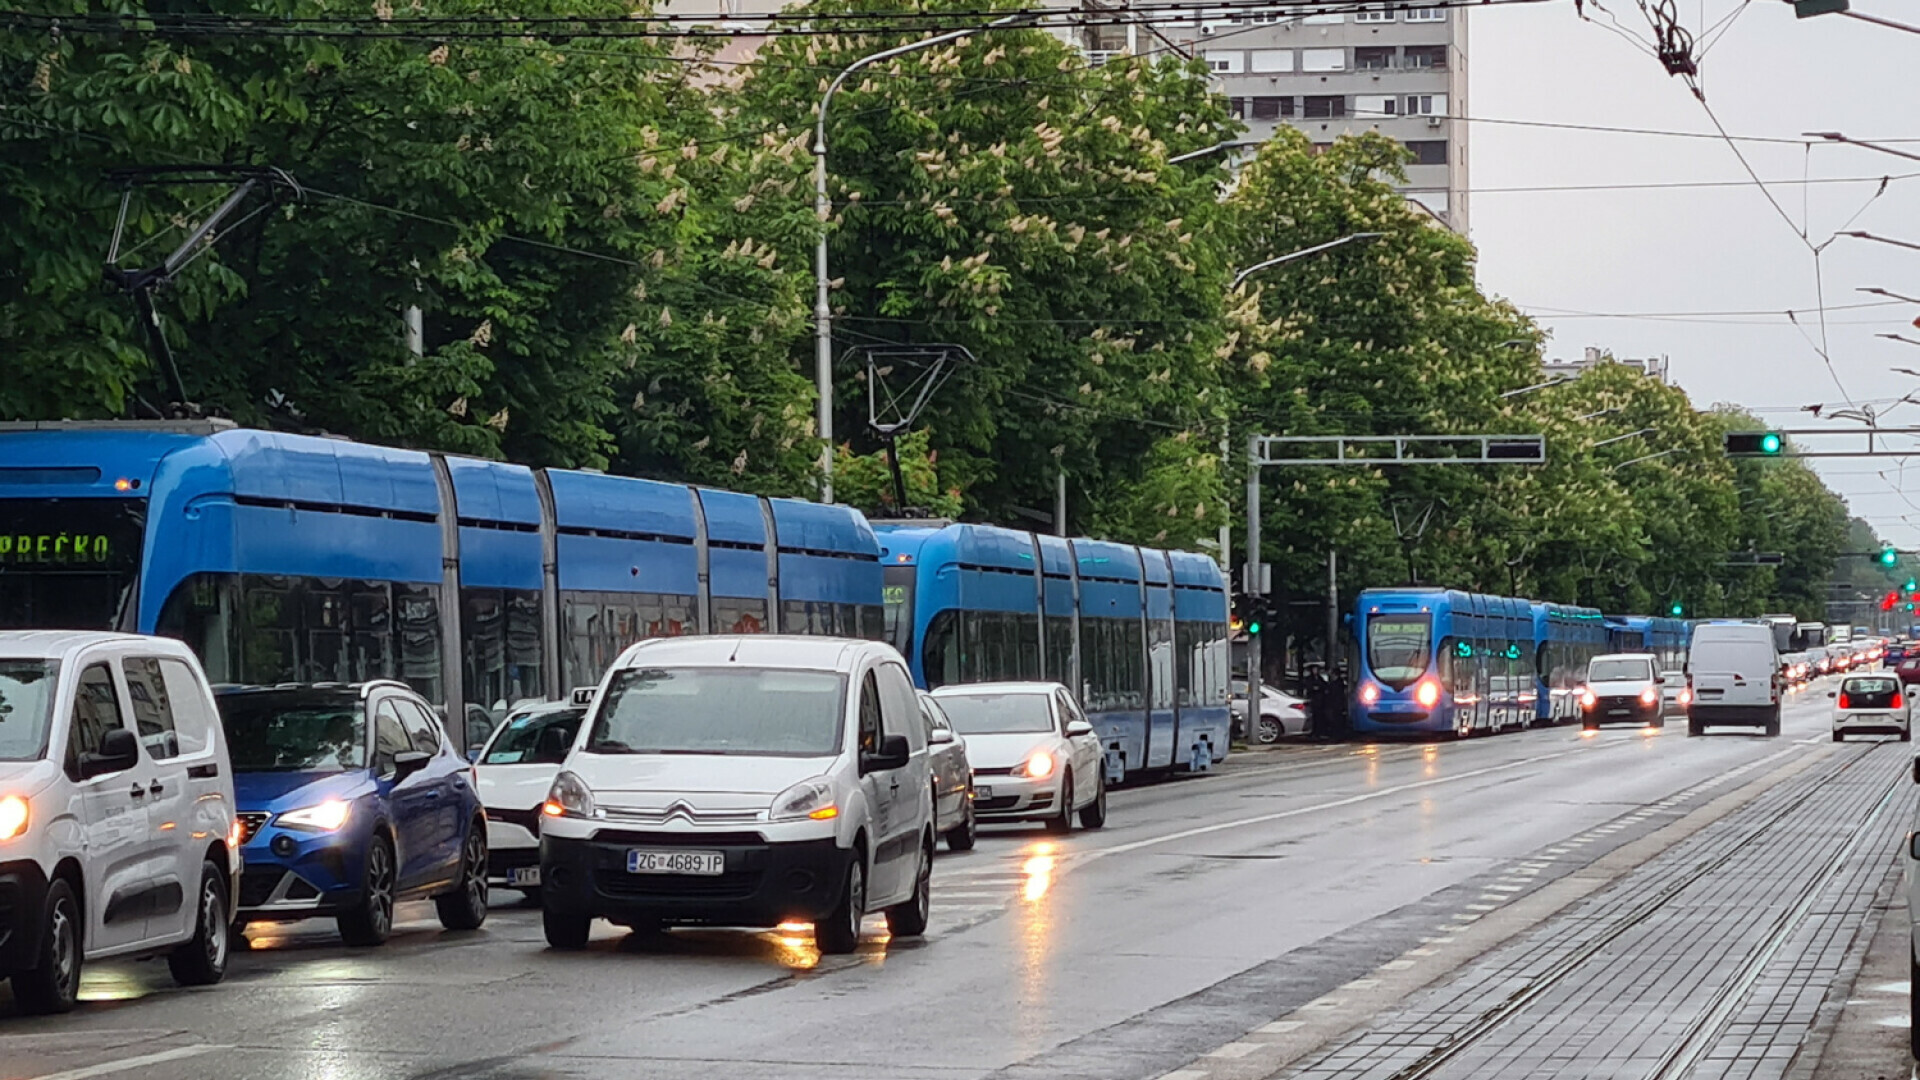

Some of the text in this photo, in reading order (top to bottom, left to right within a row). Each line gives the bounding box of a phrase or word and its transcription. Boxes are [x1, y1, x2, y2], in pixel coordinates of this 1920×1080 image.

[0, 531, 108, 562] PREČKO
[577, 690, 594, 702] TA
[639, 854, 656, 869] ZG
